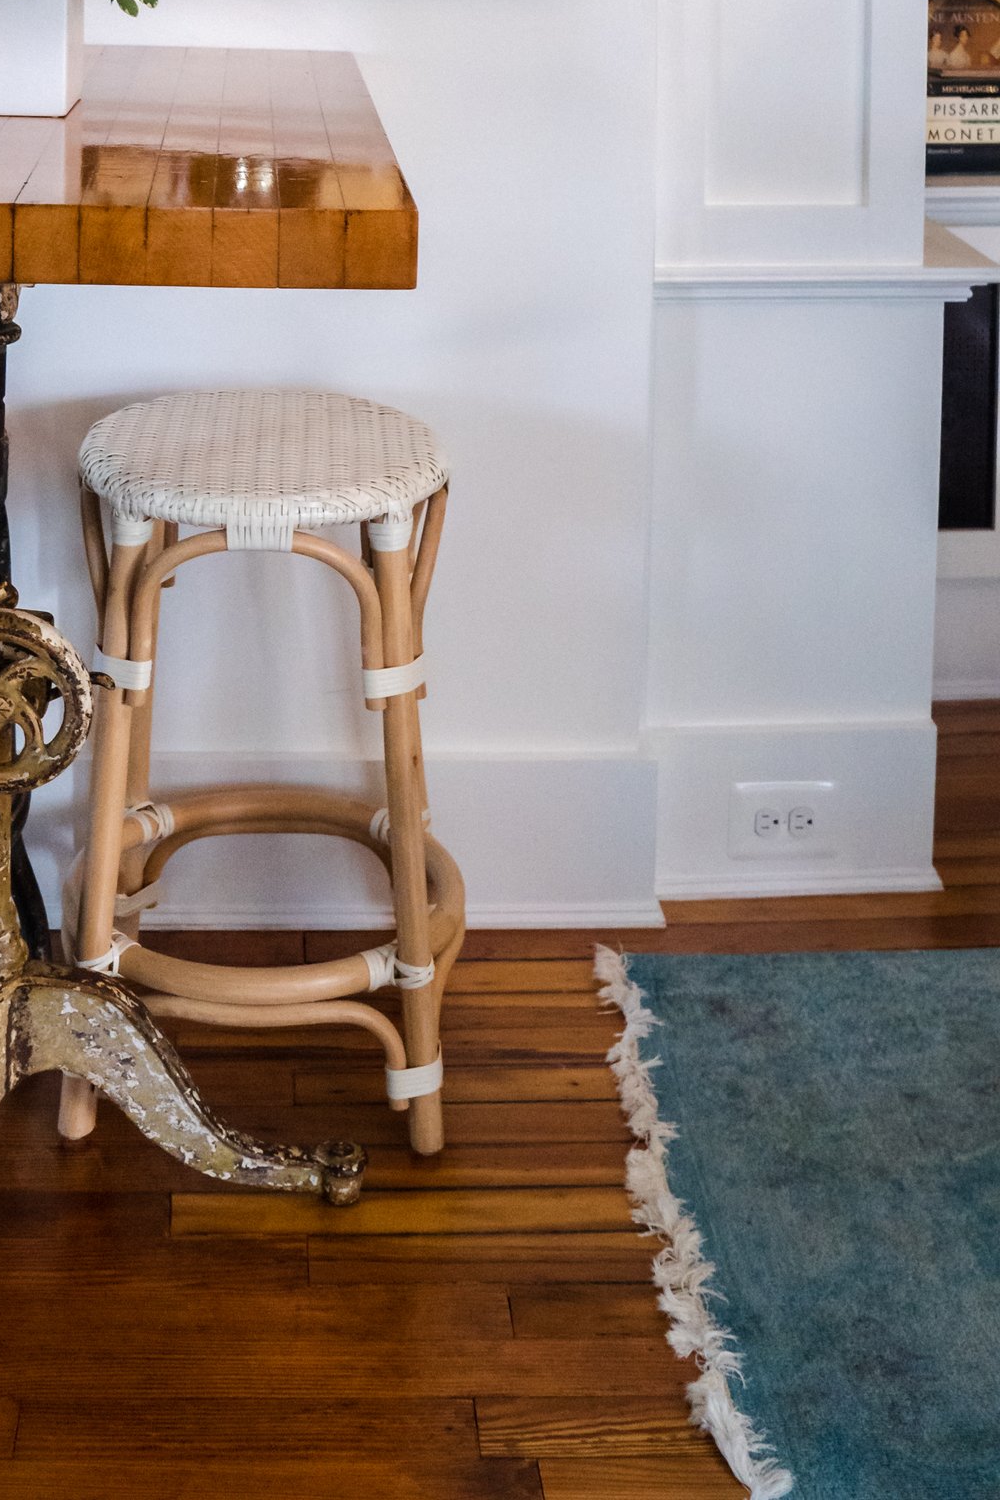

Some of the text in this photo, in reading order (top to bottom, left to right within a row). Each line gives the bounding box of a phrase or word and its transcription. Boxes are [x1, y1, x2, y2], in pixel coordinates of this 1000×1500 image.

[952, 13, 1000, 23] AUSTEN
[942, 85, 999, 94] MICHELANGELO
[934, 103, 999, 116] PISSARR
[928, 128, 994, 141] MONET
